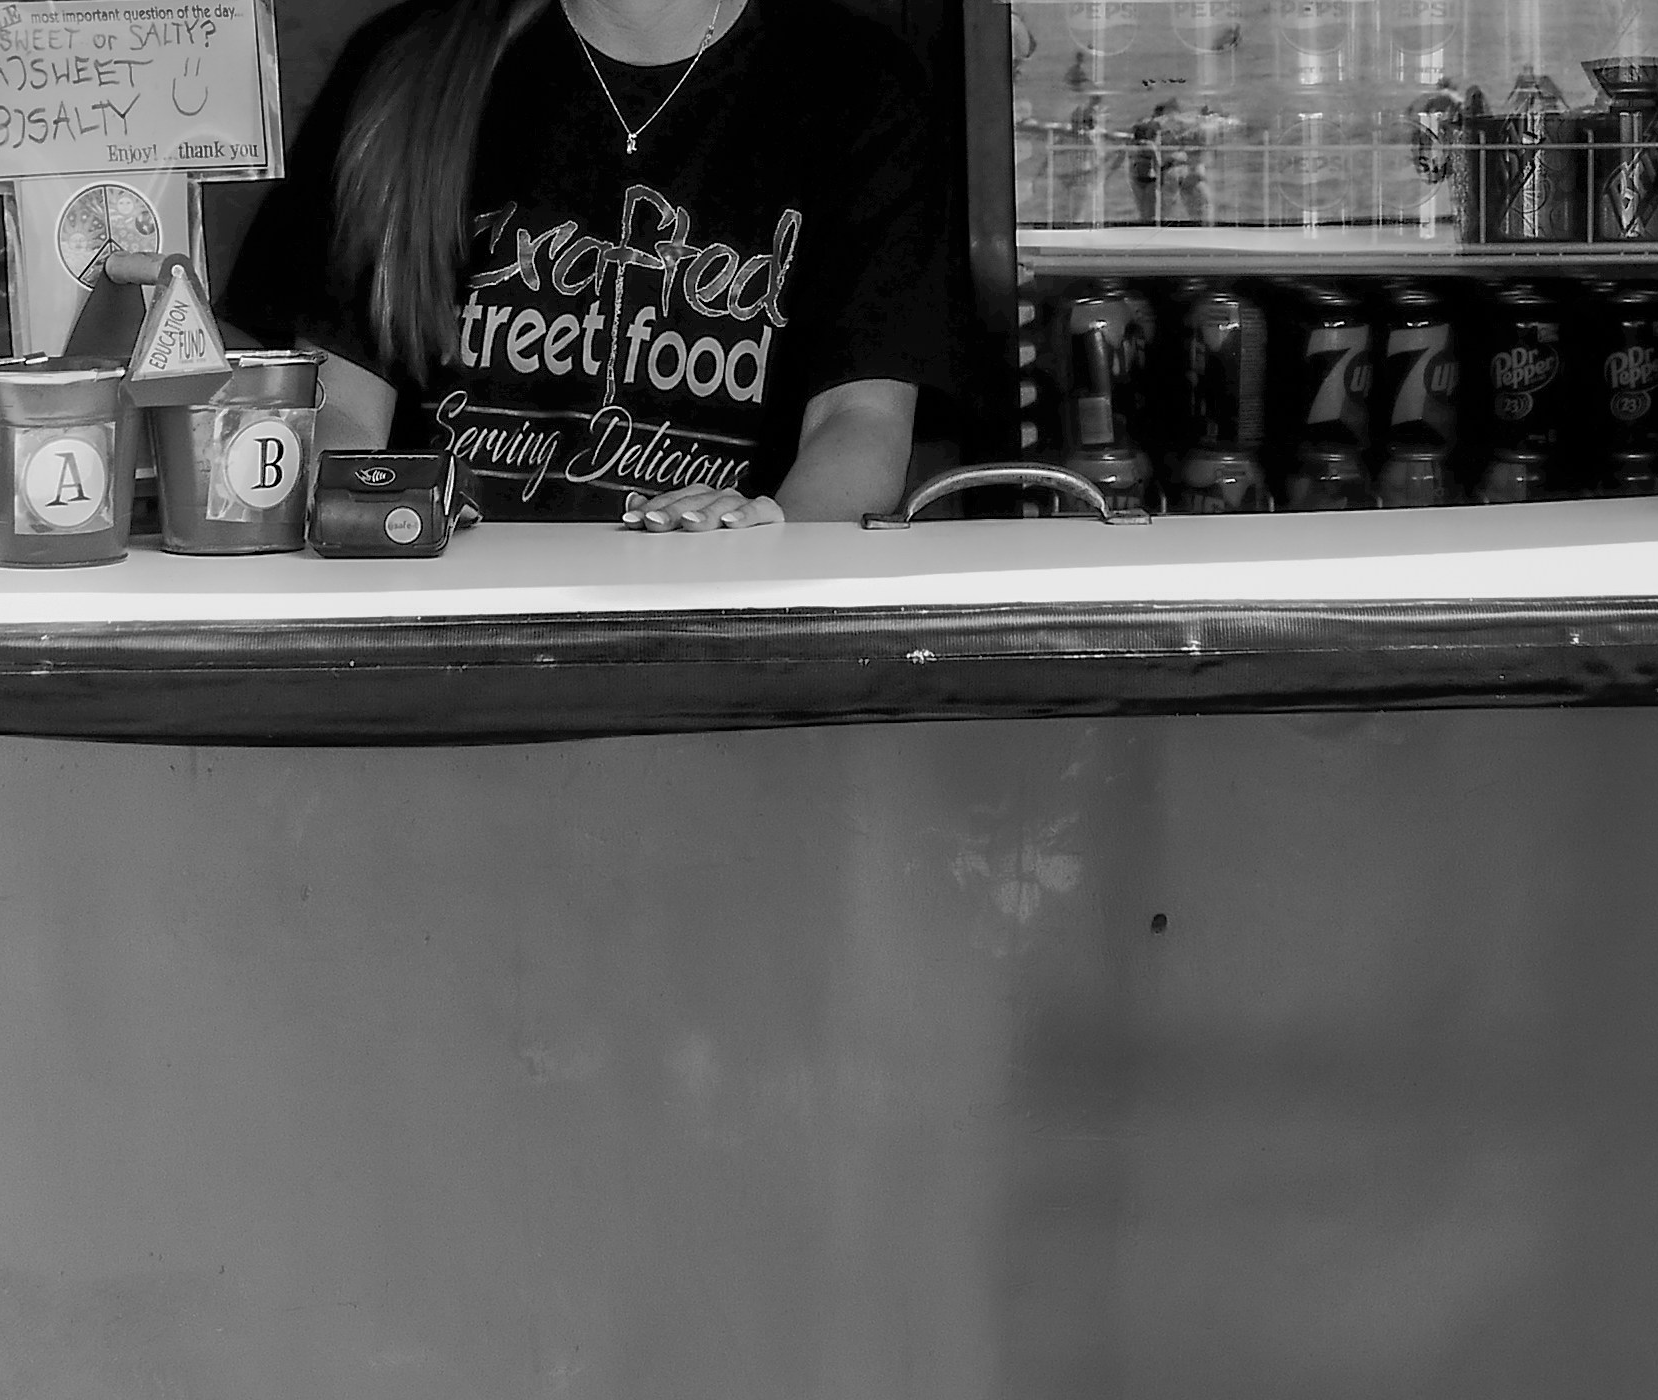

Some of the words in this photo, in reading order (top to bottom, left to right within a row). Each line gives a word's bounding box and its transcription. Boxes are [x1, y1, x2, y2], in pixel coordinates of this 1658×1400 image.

[31, 12, 59, 24] most
[63, 9, 119, 25] important
[123, 8, 174, 23] question
[177, 5, 189, 19] of
[192, 4, 211, 18] the
[0, 27, 80, 51] SWEET
[93, 34, 118, 50] or
[129, 19, 217, 50] SALTY?
[107, 144, 158, 163] Enjoy!
[231, 144, 259, 159] you
[148, 300, 189, 369] EDUCATION
[179, 328, 207, 360] FUND
[461, 291, 606, 376] treet
[624, 306, 771, 403] food
[1512, 347, 1538, 366] Dr
[1629, 346, 1654, 366] Dr
[1496, 356, 1556, 389] Pepper
[436, 391, 560, 502] Serving
[566, 406, 754, 488] Delicious
[45, 452, 91, 506] A
[251, 437, 283, 490] B
